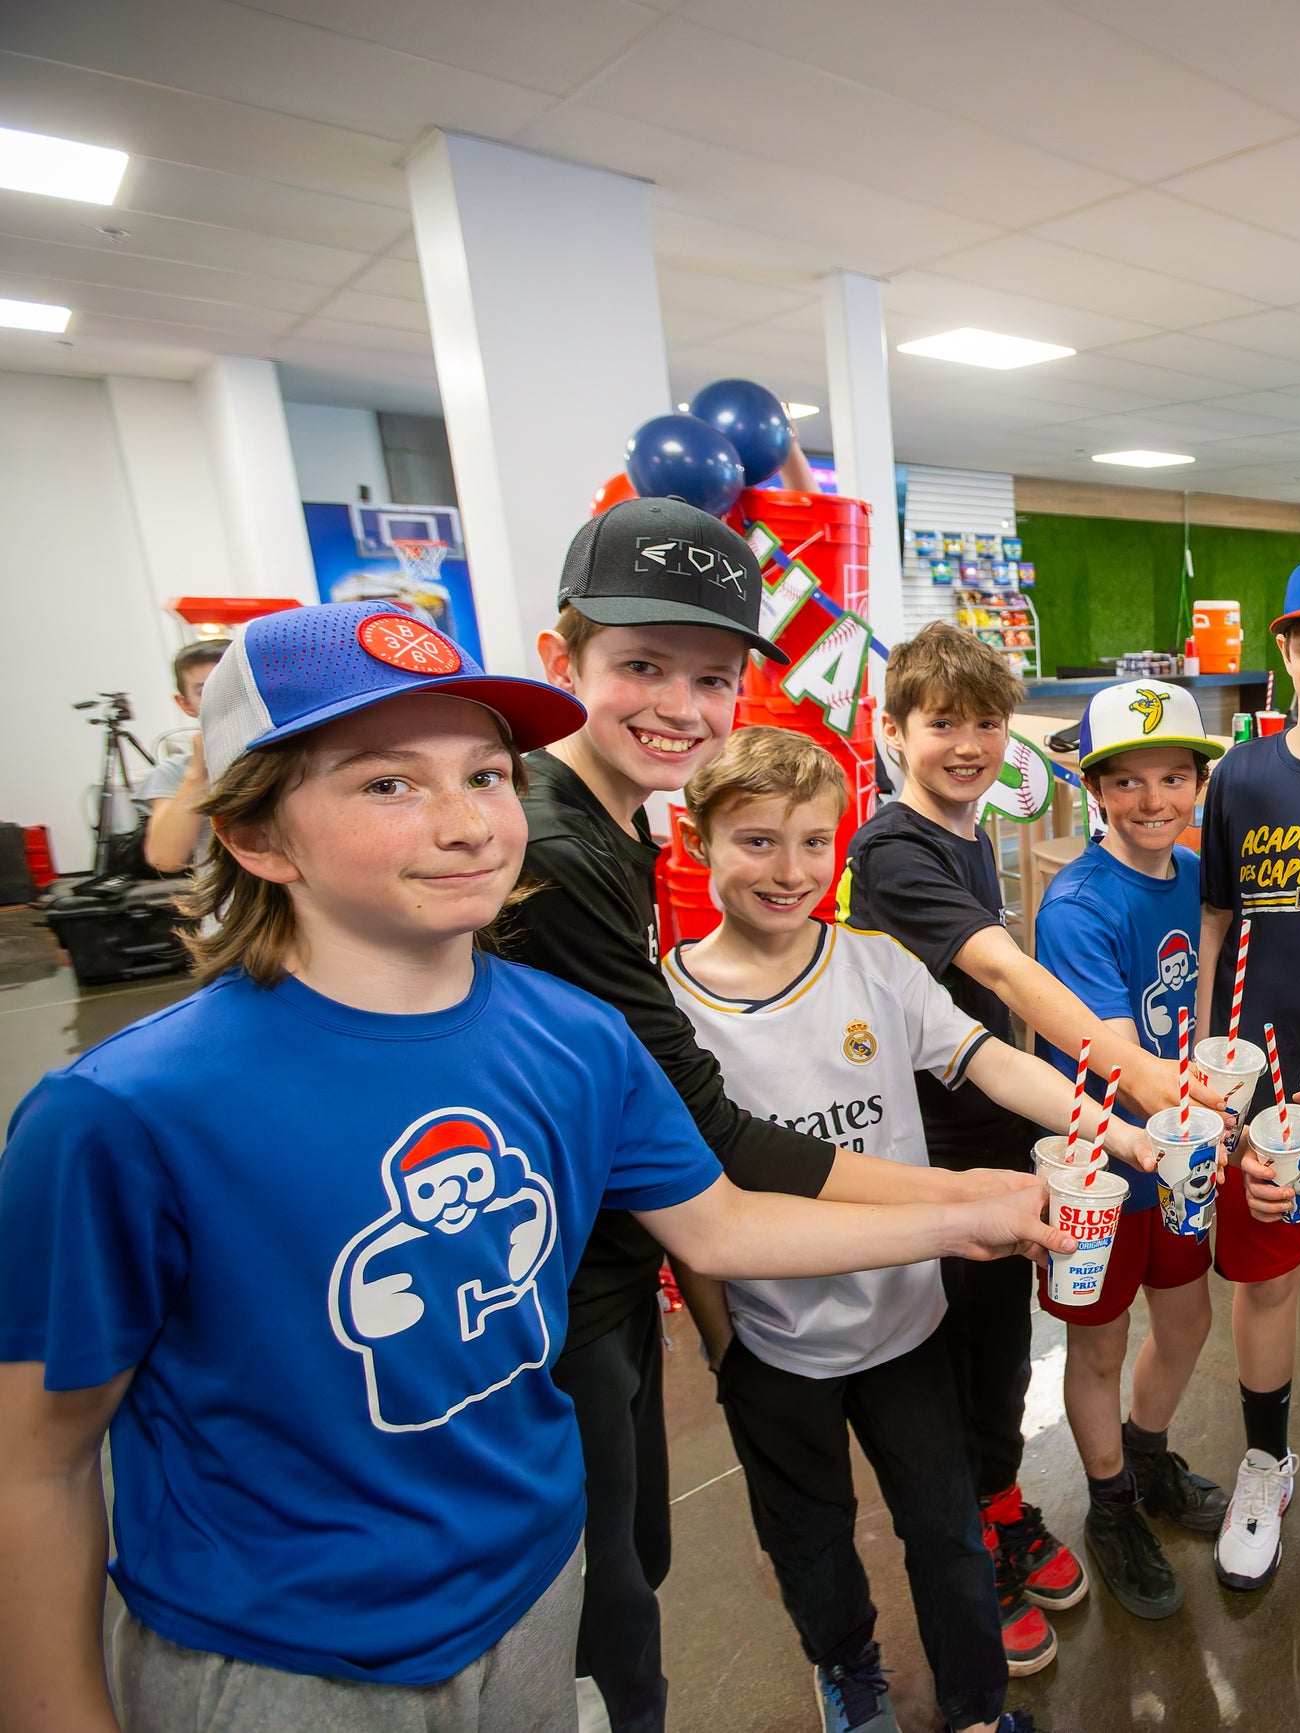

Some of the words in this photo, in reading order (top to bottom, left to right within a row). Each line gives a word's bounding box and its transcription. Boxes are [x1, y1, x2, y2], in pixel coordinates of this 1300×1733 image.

[1239, 864, 1256, 882] DES
[1079, 1238, 1109, 1250] ORIGINAL
[1069, 1264, 1105, 1276] PRIZES
[1072, 1280, 1098, 1291] PRIX
